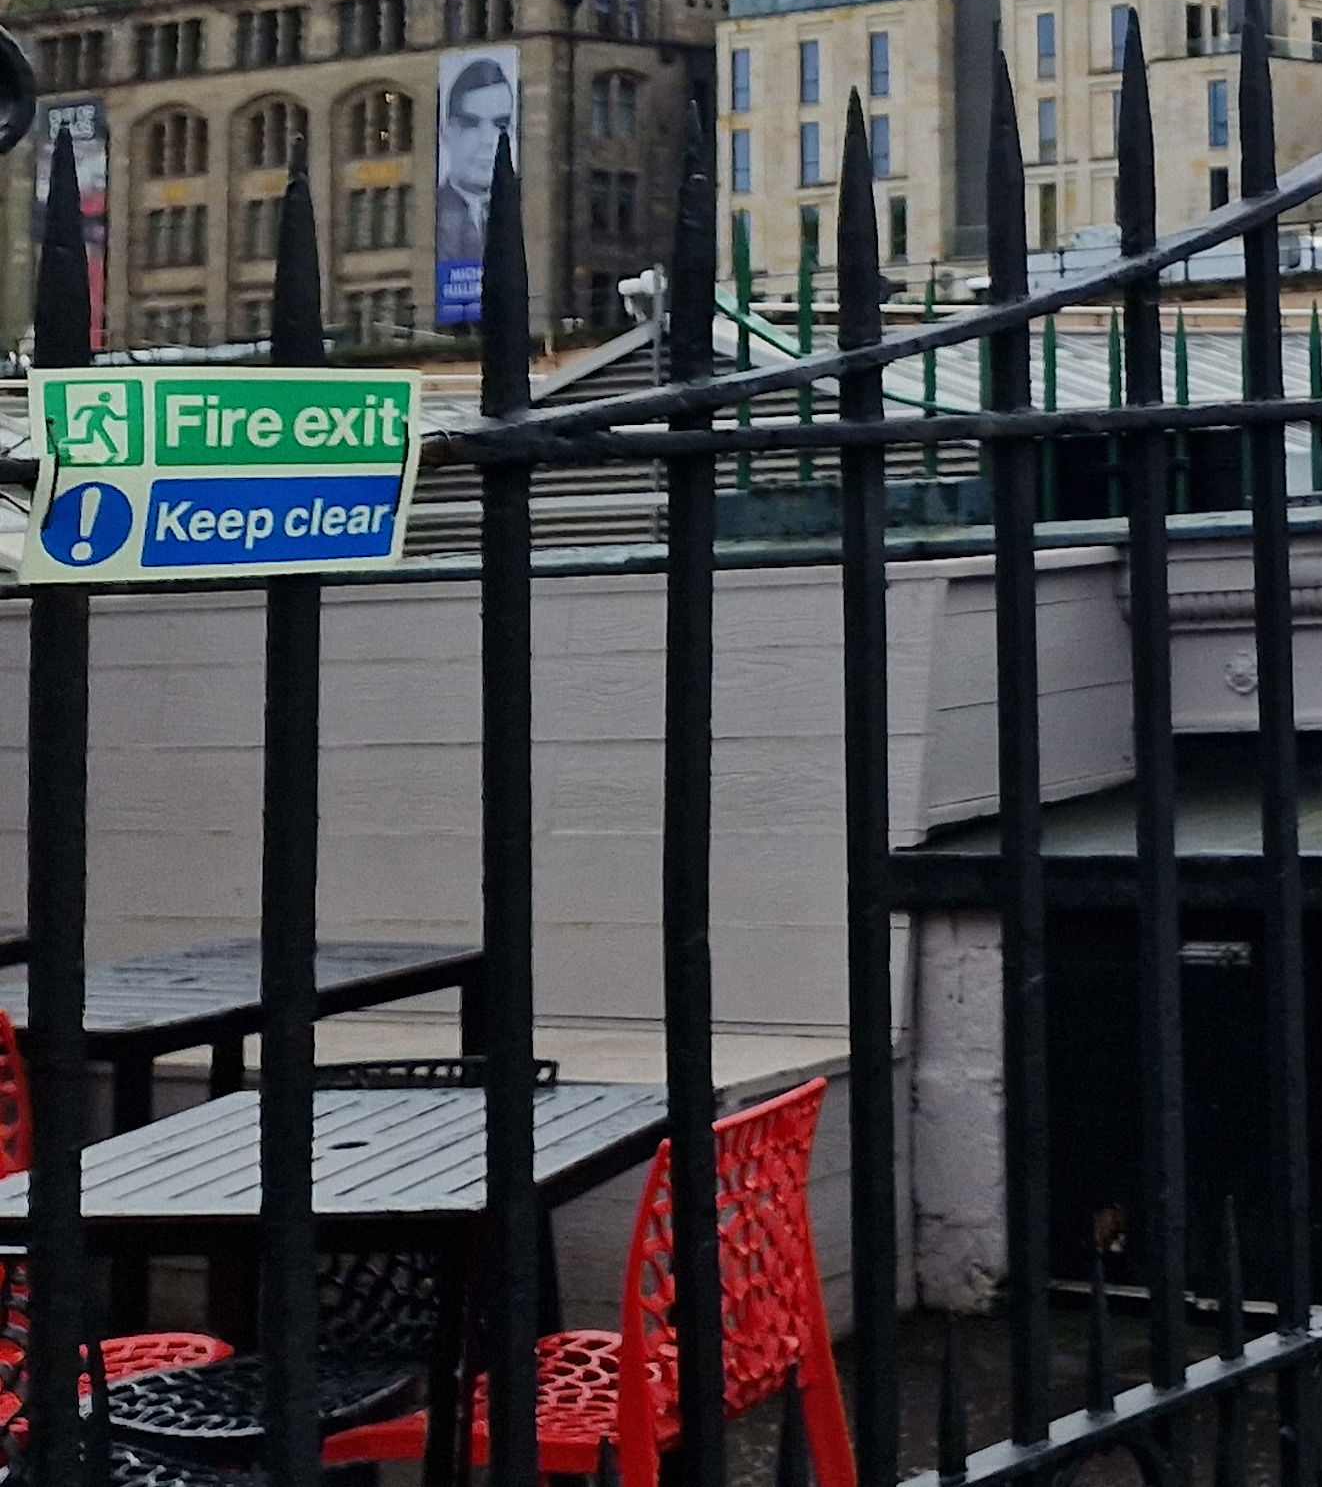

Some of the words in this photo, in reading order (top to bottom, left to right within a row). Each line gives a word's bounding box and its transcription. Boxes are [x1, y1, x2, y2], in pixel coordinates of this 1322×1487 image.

[165, 394, 282, 448] Fire
[293, 394, 404, 448] exit
[155, 500, 273, 550] Keep
[284, 498, 393, 536] clear
